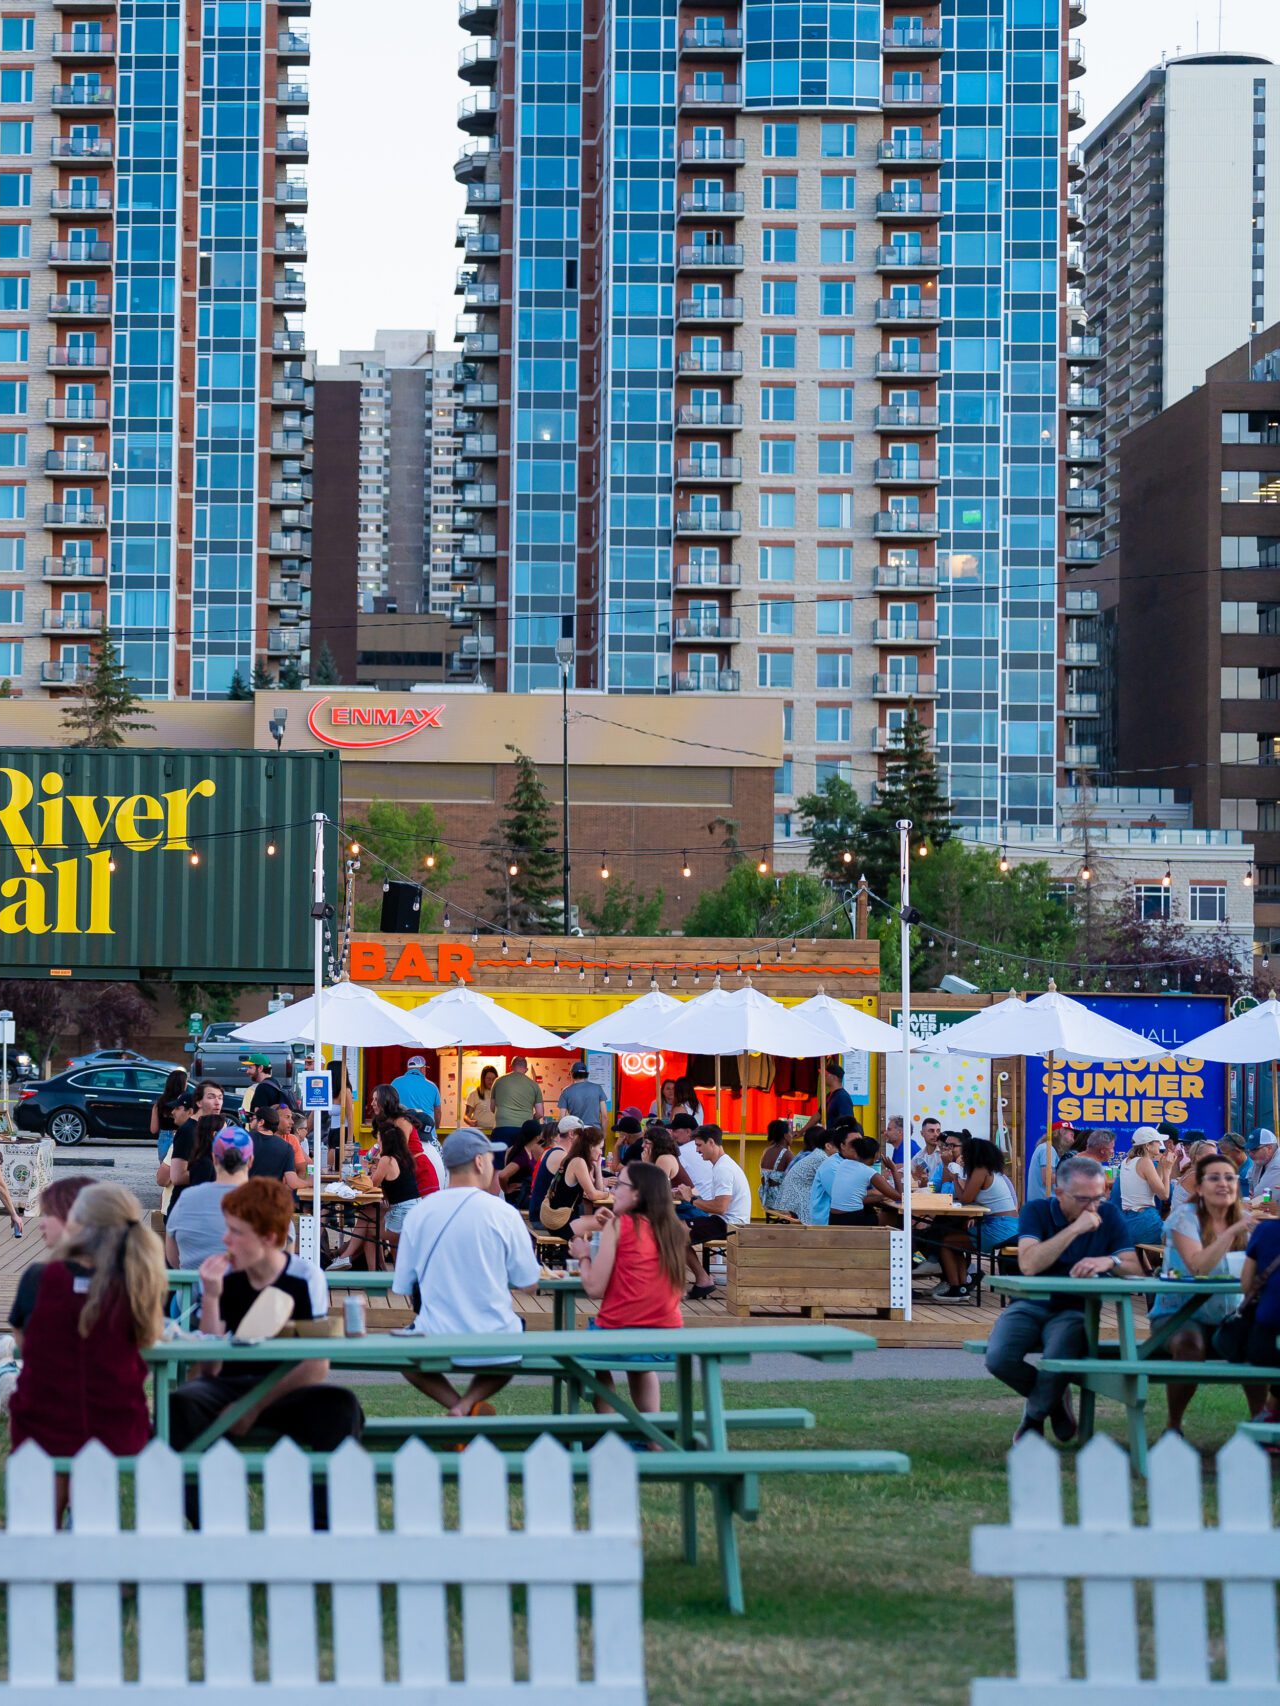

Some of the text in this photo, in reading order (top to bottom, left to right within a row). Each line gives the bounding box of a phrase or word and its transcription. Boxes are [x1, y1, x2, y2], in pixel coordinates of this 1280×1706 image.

[331, 704, 446, 728] ENMAX
[350, 941, 475, 982] BAR
[898, 1022, 937, 1032] VER
[1042, 1072, 1205, 1099] SUMMER
[1057, 1097, 1189, 1124] SERIES
